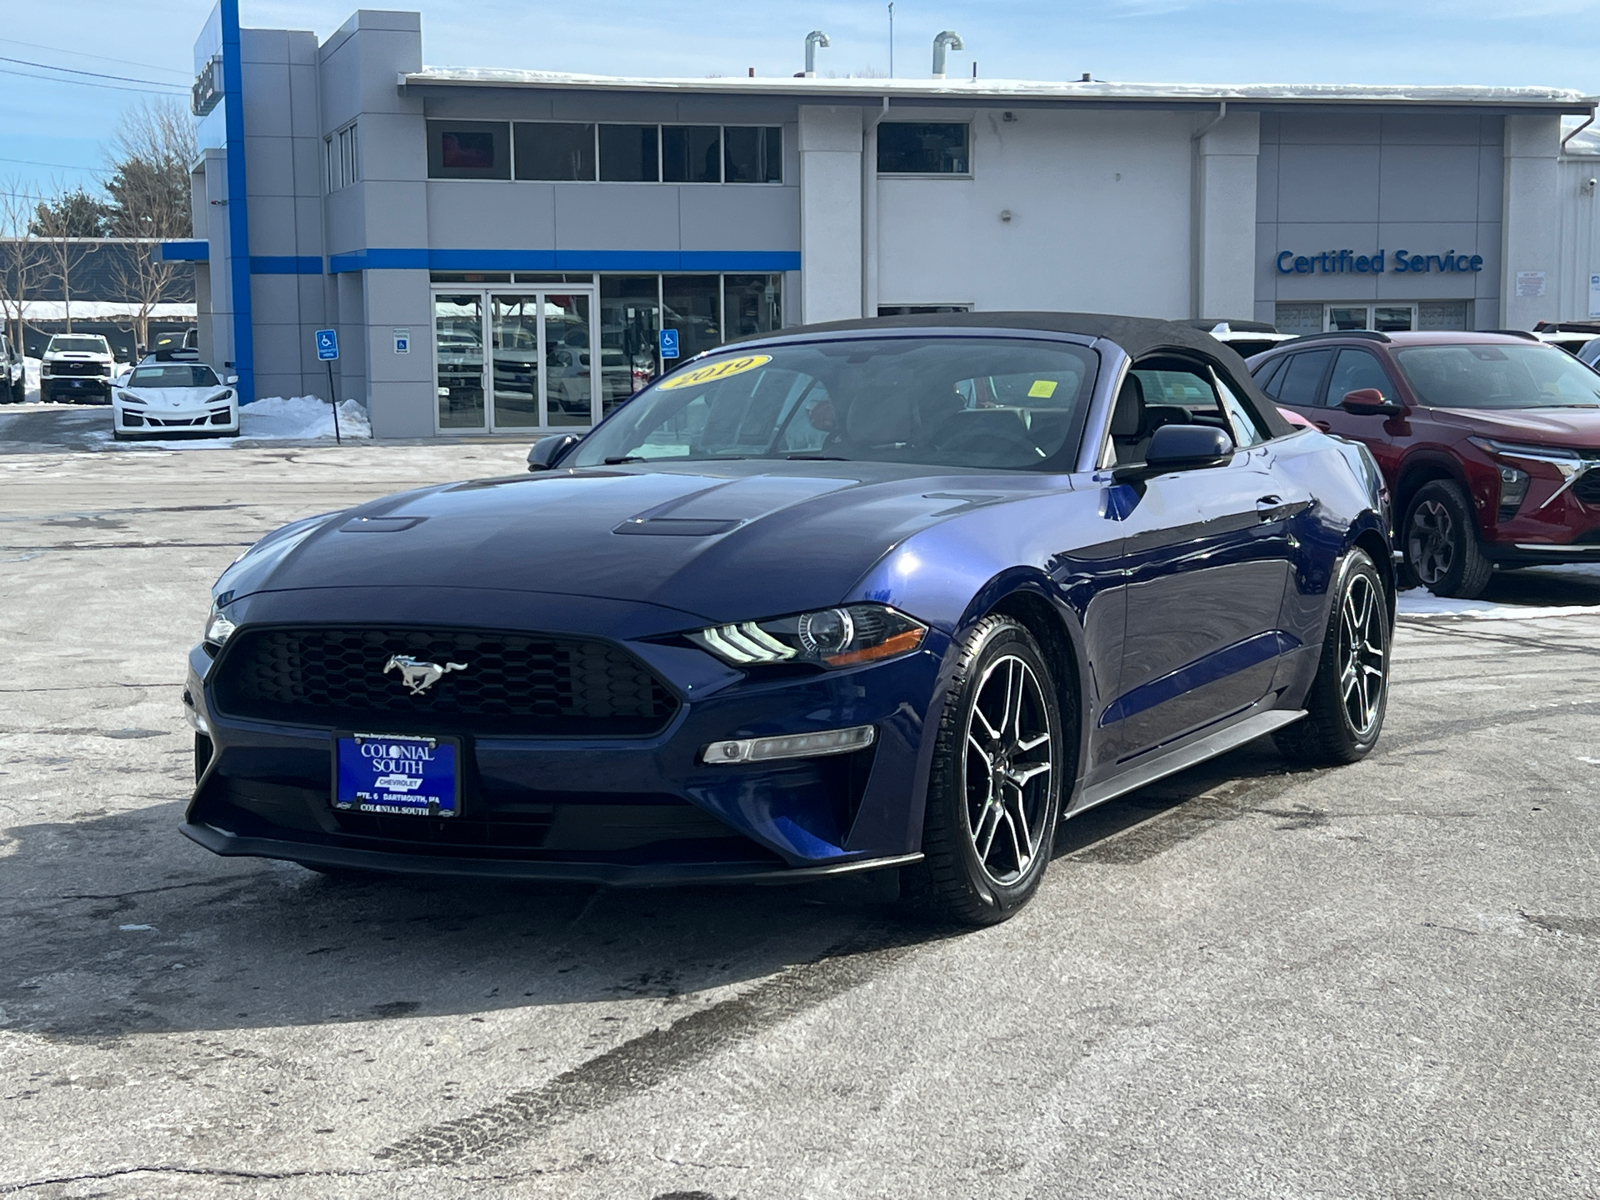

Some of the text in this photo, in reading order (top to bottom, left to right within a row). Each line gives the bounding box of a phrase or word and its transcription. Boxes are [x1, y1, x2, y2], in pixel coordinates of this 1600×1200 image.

[1276, 248, 1484, 275] Certified Service
[672, 358, 755, 387] 2019
[361, 743, 435, 761] COLONIAL
[372, 758, 423, 775] SOUTH
[379, 779, 418, 787] CHEVROLET
[360, 803, 430, 816] COLONIAL SOUTH
